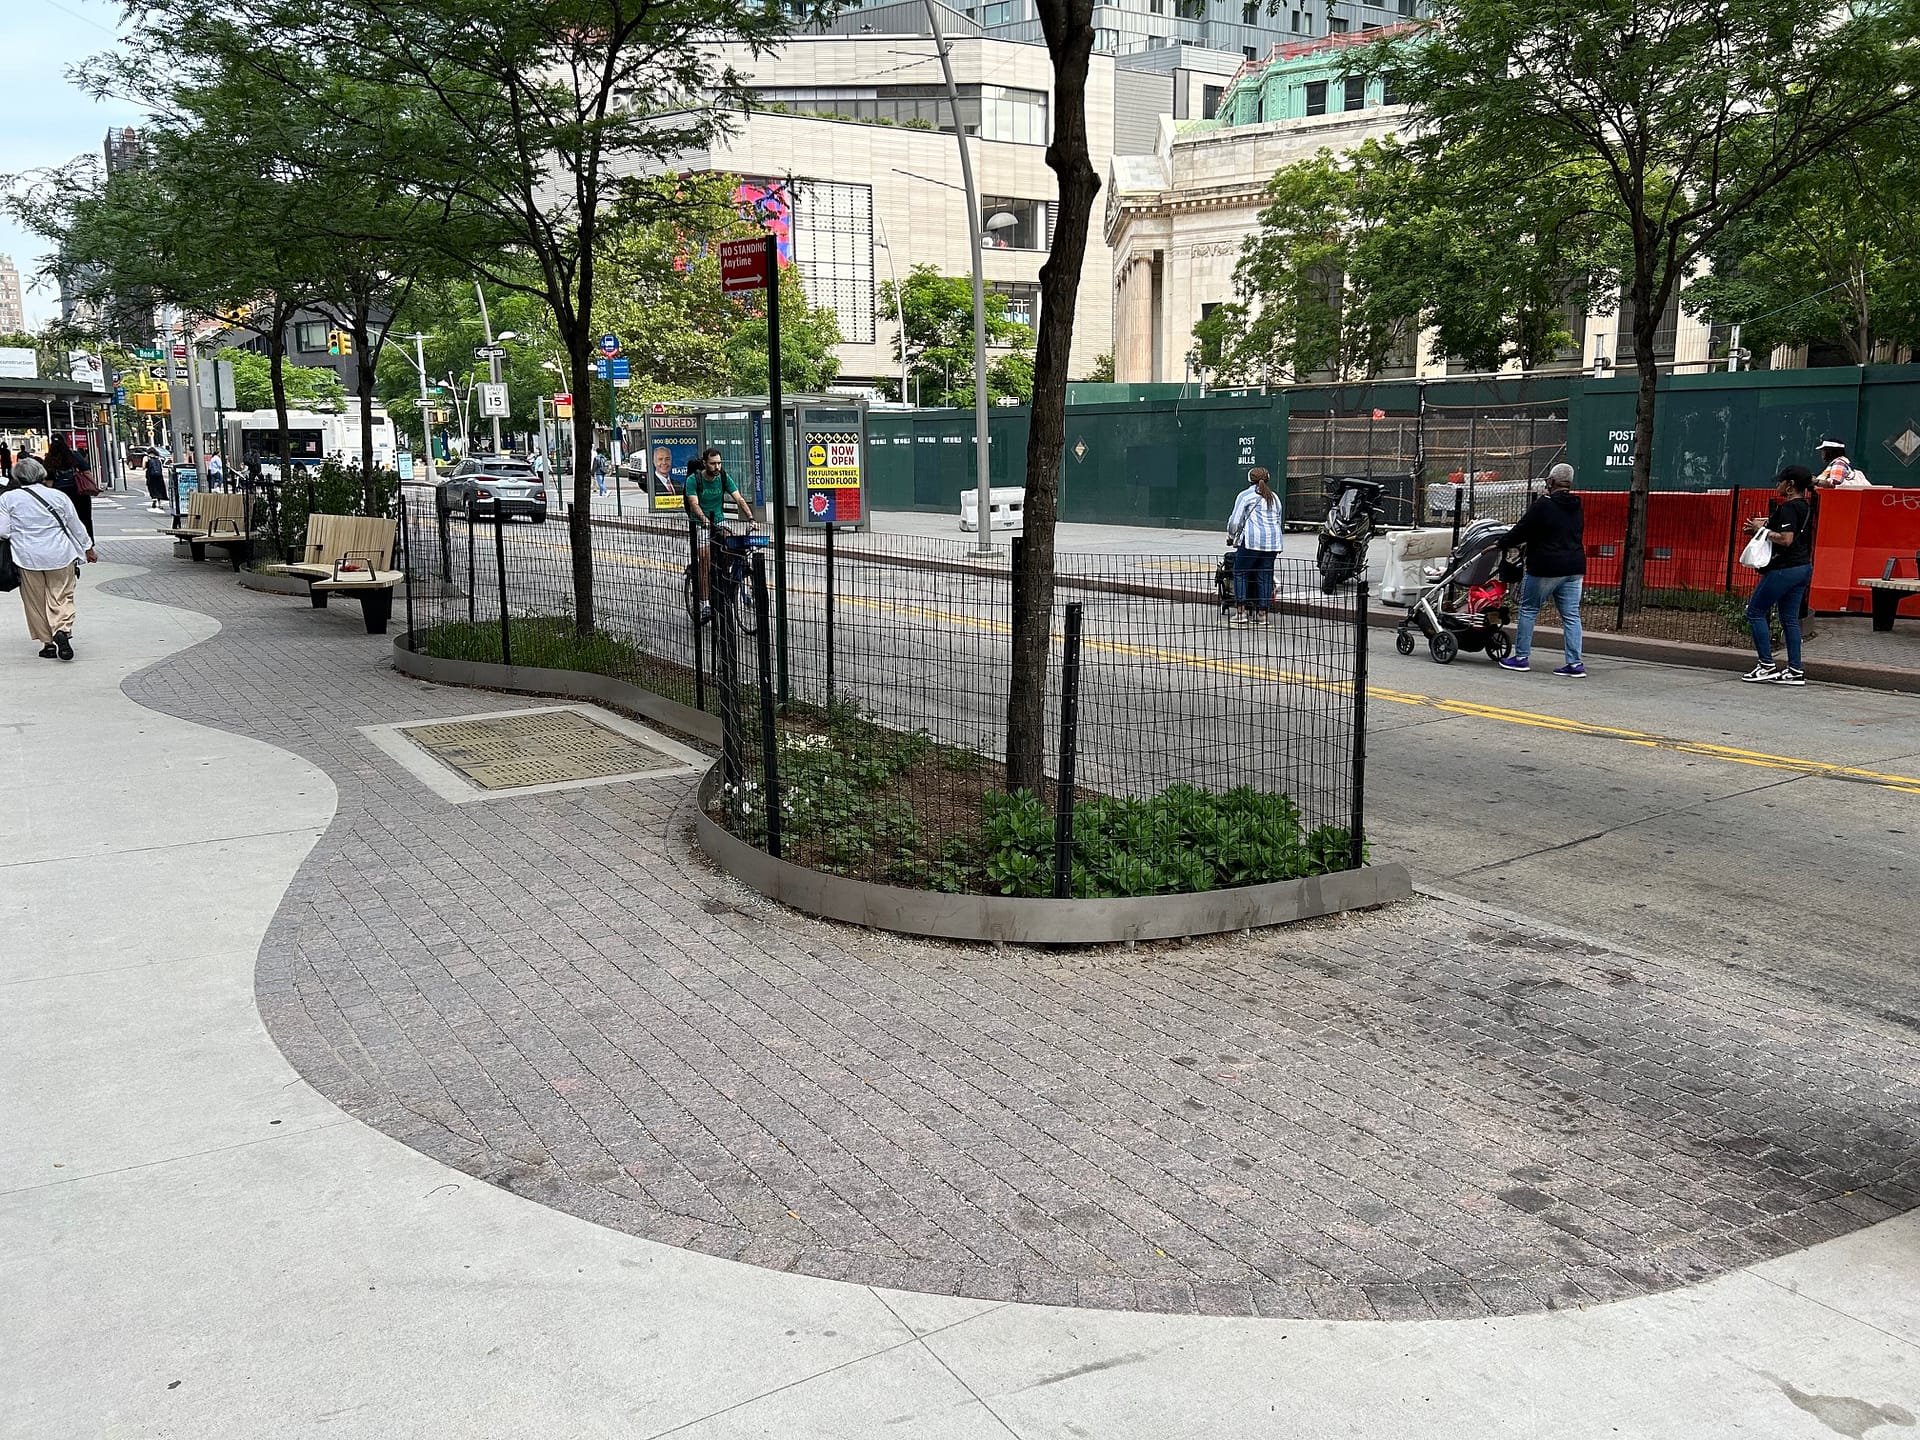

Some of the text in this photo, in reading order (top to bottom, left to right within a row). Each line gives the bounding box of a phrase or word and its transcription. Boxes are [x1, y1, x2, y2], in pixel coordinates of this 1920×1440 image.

[722, 242, 767, 256] NO STANDING
[724, 257, 752, 269] Anytime
[488, 397, 502, 407] 15
[652, 418, 697, 428] INJURED?
[1609, 431, 1635, 440] POST
[1239, 437, 1255, 445] POST
[831, 445, 854, 456] NOW
[1242, 446, 1252, 455] NO
[1614, 443, 1629, 453] NO
[831, 456, 855, 466] OPEN
[1238, 456, 1255, 464] BILLS
[1606, 456, 1635, 465] BILLS
[808, 477, 858, 485] SECOND FLOOR
